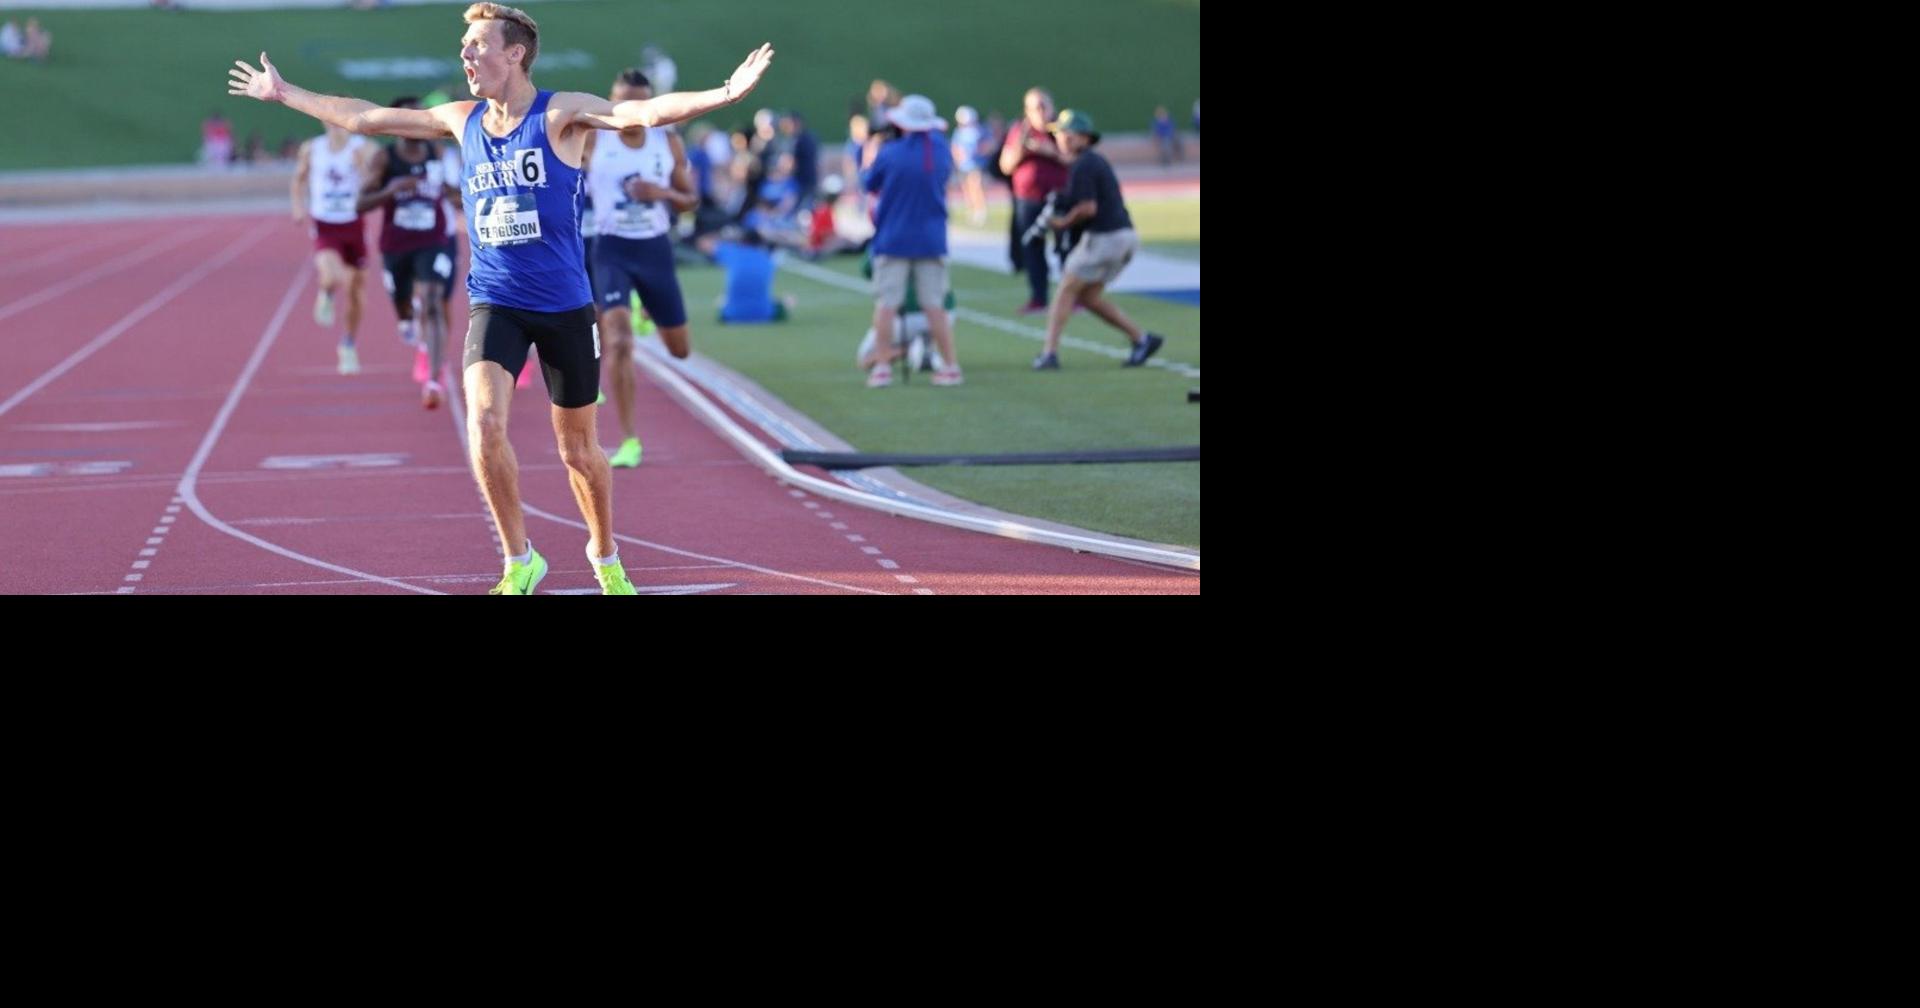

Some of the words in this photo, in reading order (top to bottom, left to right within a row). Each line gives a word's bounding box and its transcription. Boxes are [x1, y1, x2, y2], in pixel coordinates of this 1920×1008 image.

[476, 160, 516, 173] NEBRAS
[522, 151, 539, 182] 6
[468, 171, 548, 195] KEARN
[480, 222, 537, 239] FERGUSON
